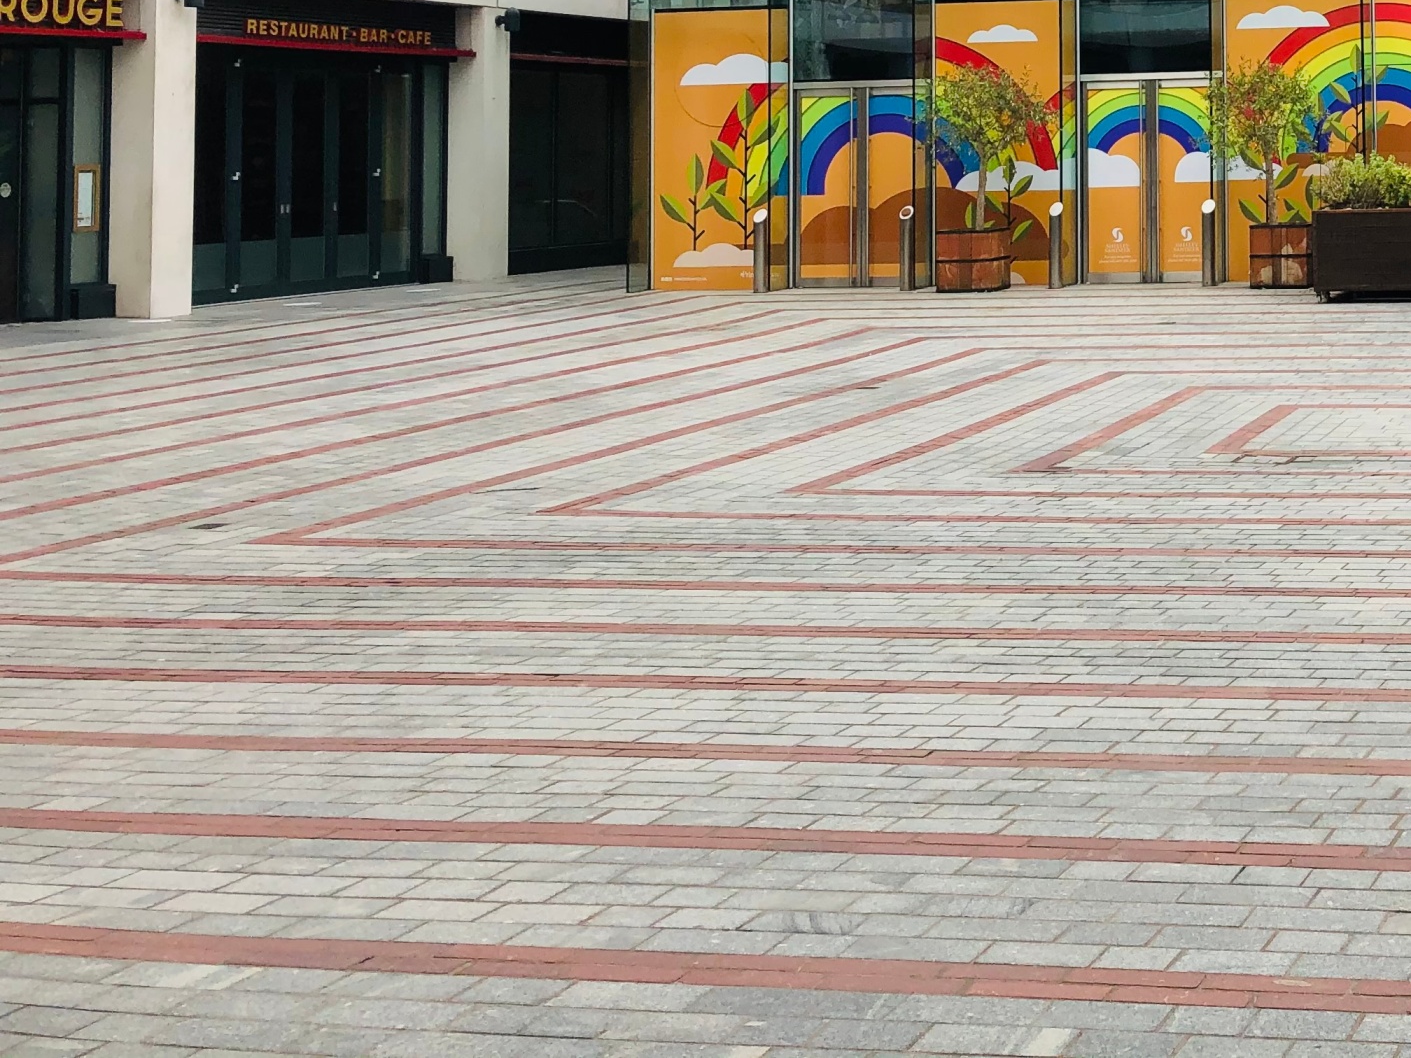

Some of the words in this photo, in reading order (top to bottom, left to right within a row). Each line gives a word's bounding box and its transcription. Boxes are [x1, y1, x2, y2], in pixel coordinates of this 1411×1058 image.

[246, 18, 350, 41] RESTAURANT
[360, 28, 388, 43] BAR
[397, 29, 432, 45] CAFE
